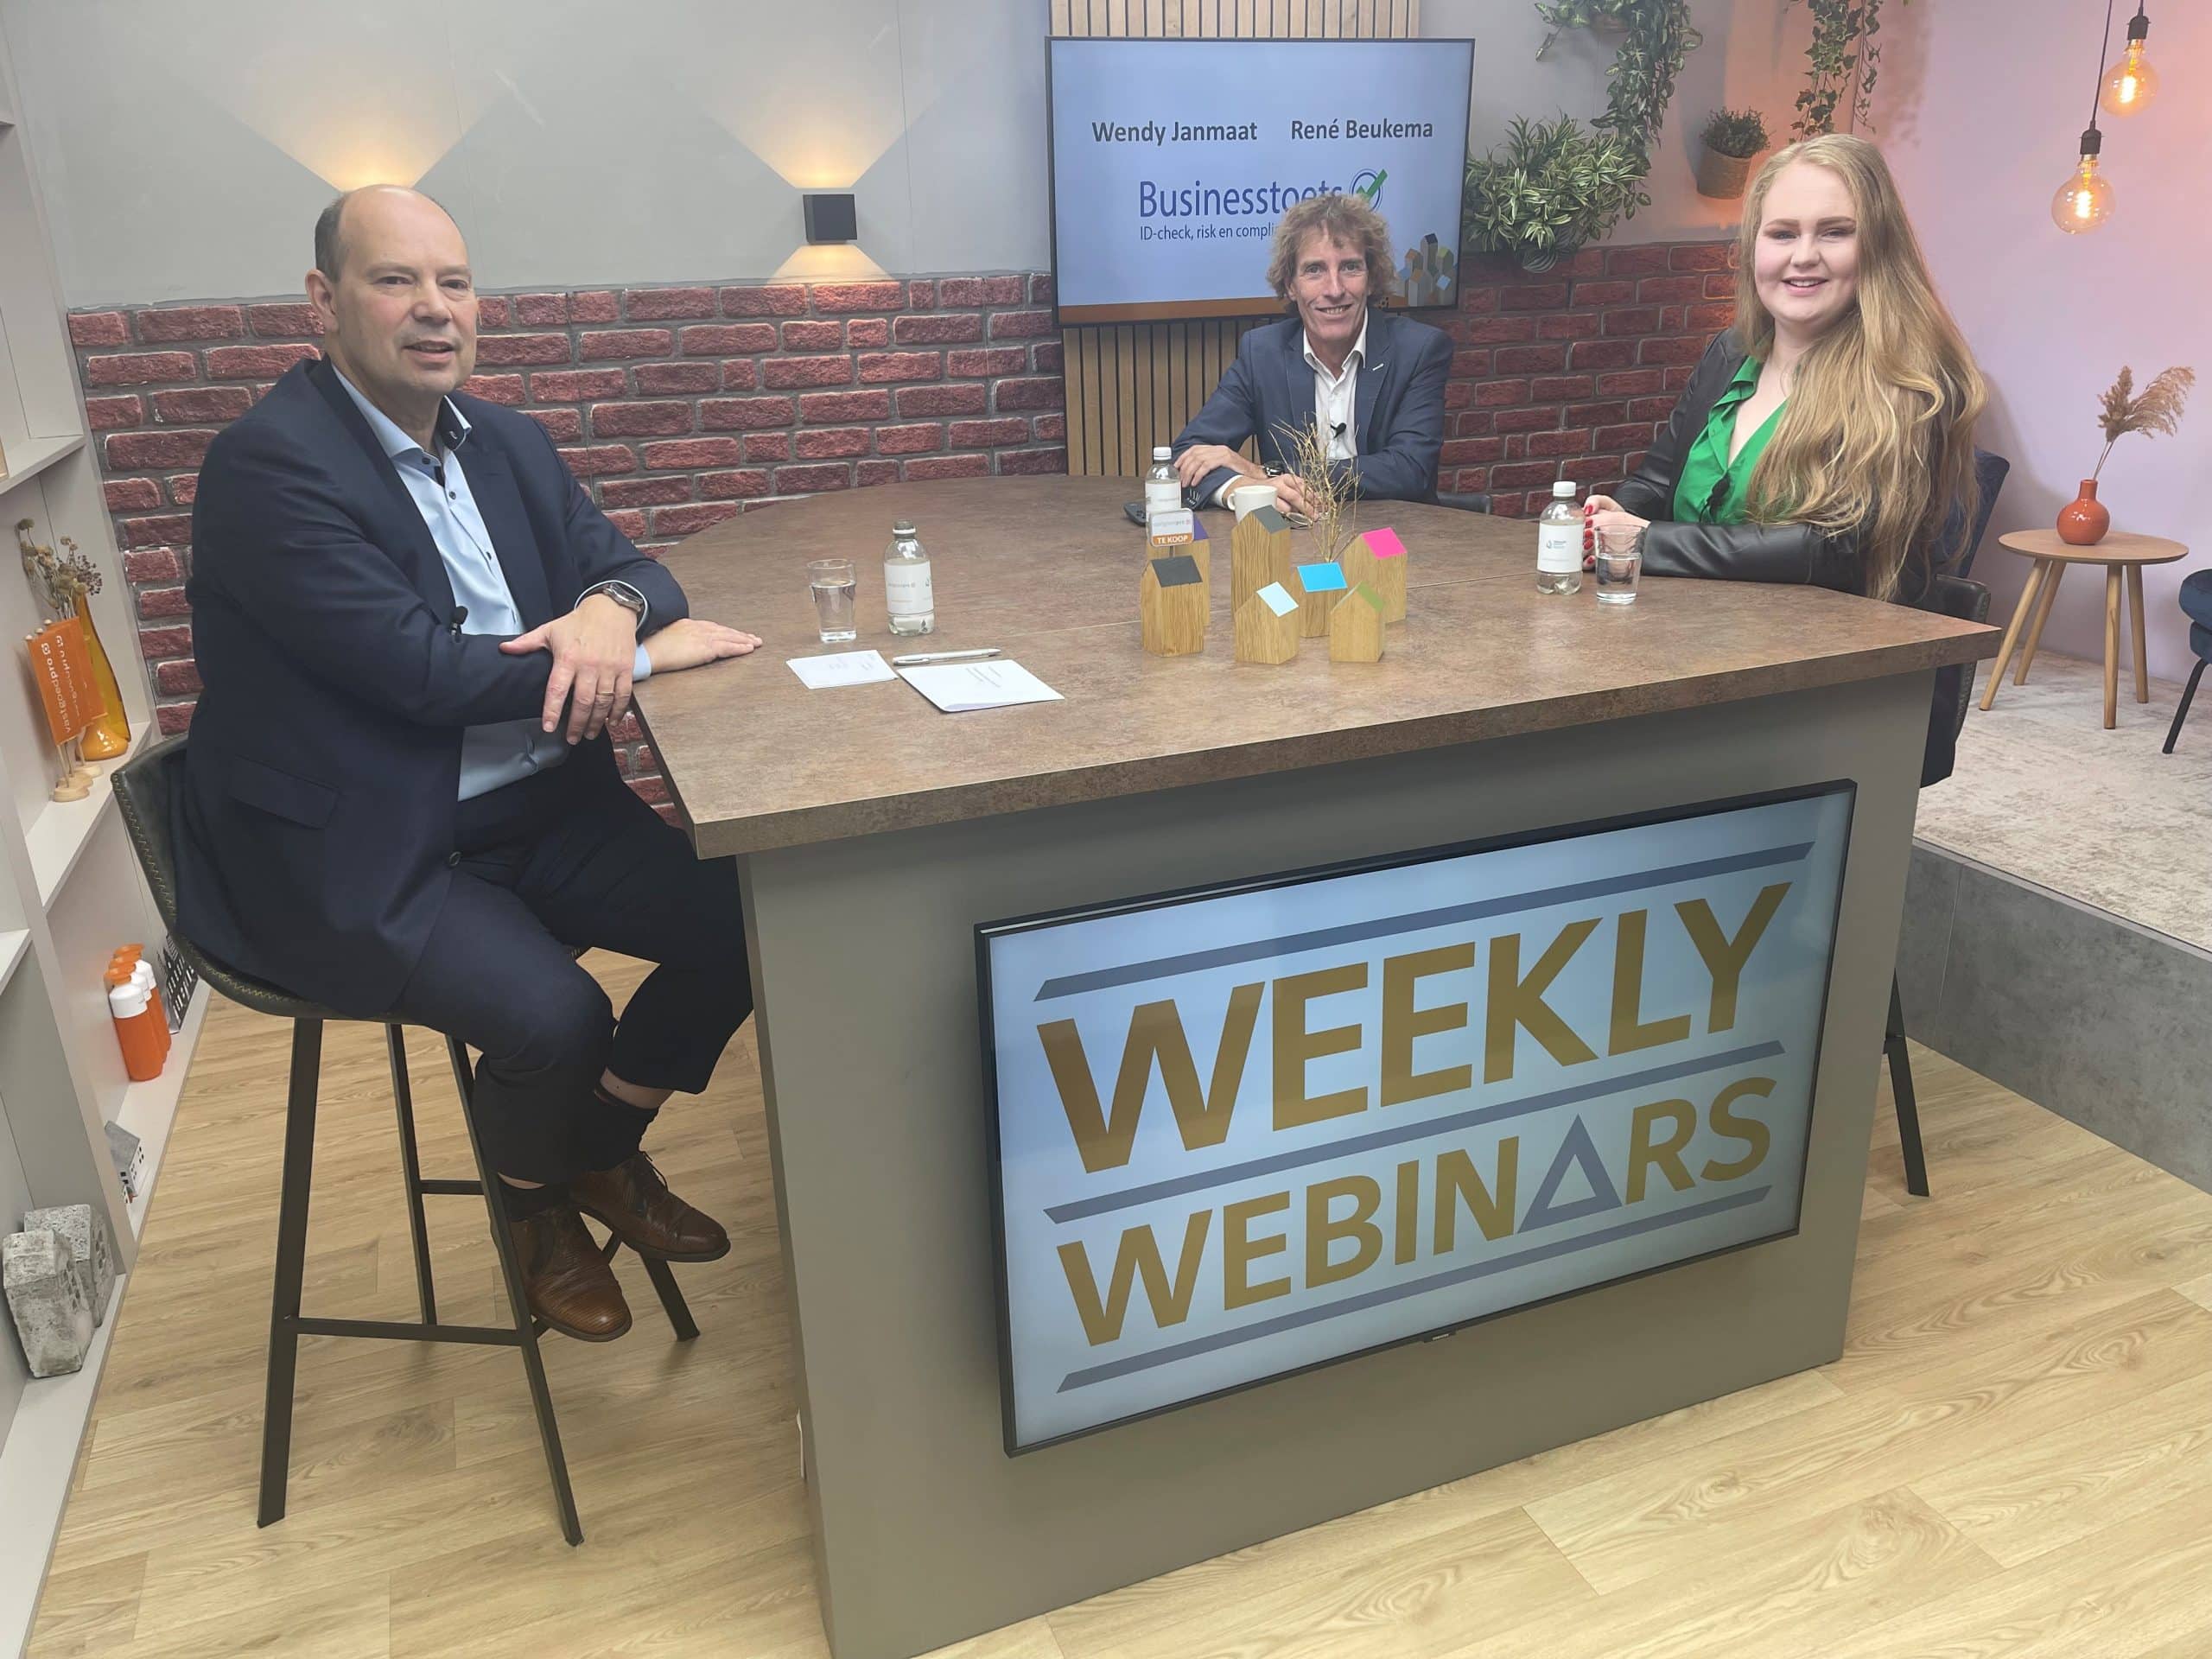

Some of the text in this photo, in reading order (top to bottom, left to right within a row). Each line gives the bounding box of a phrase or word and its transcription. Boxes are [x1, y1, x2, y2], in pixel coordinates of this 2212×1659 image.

[1091, 120, 1258, 147] Wendy Janmaat
[1291, 118, 1433, 140] René Beukema
[1141, 222, 1274, 241] ID-check, risk en compli
[1035, 881, 1792, 1173] WEEKLY
[1057, 1077, 1777, 1346] WEBINARS
